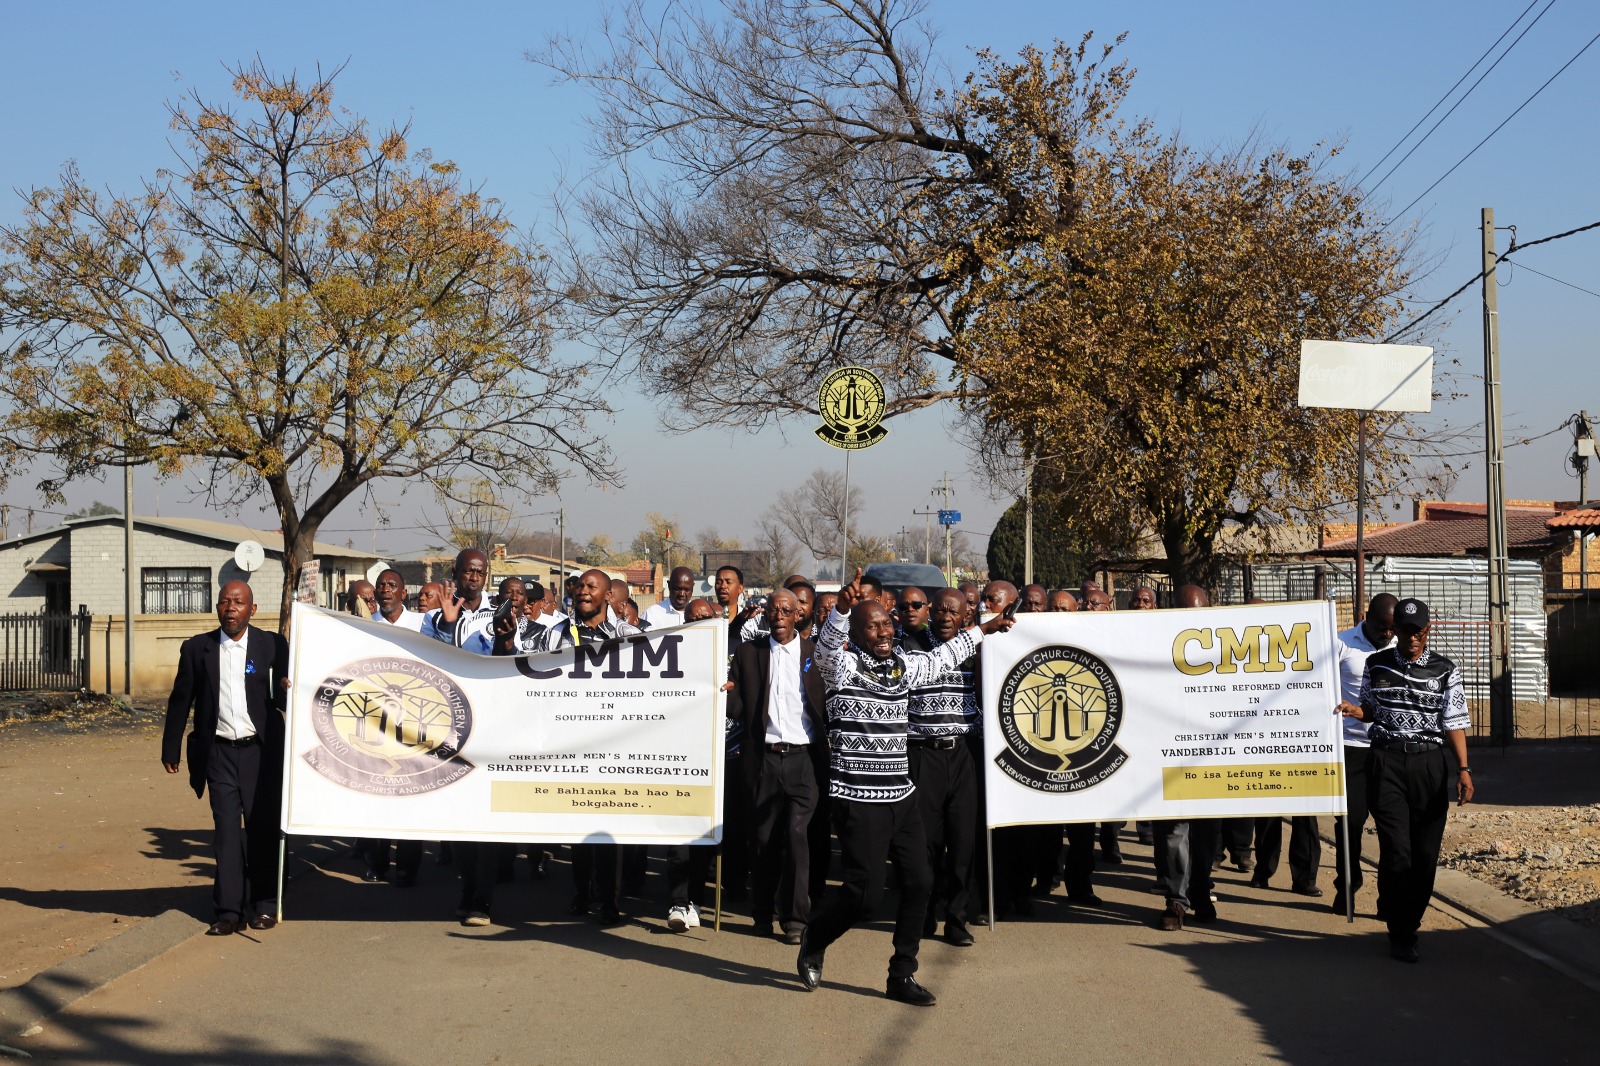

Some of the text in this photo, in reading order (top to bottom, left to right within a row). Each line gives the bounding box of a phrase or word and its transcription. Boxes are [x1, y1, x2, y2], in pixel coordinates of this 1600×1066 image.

[1172, 622, 1314, 676] CMM
[515, 635, 684, 679] CMM
[362, 661, 423, 676] CHURCH
[422, 669, 436, 680] IN
[318, 668, 360, 713] REFORMD
[1184, 685, 1226, 693] UNITING
[1232, 683, 1280, 692] REFORMED
[435, 679, 465, 729] SOUTHERN
[1002, 650, 1118, 756] UNITING REFORMED CHURCH IN SOUTHERN AFRICA
[1210, 710, 1258, 718] SOUTHERN
[319, 716, 349, 756] UNITING
[1175, 734, 1228, 742] CHRISTIAN
[1162, 744, 1334, 758] VANDERBIJL CONGREGATION
[307, 755, 471, 795] IN SERVICE OF CHRIST AND HIS CHURCH
[487, 764, 709, 776] SHARPEVILLE CONGREGATION
[998, 755, 1125, 791] IN SERVICE OF CHRIST AND HIS CHURCH
[1051, 772, 1074, 780] CMM
[1227, 770, 1263, 780] Lefung
[1287, 769, 1318, 777] ntswe
[376, 776, 405, 784] CMM
[1246, 782, 1293, 790] itlamo..
[557, 787, 616, 795] Bahlanka
[572, 799, 652, 809] bokgabane..
